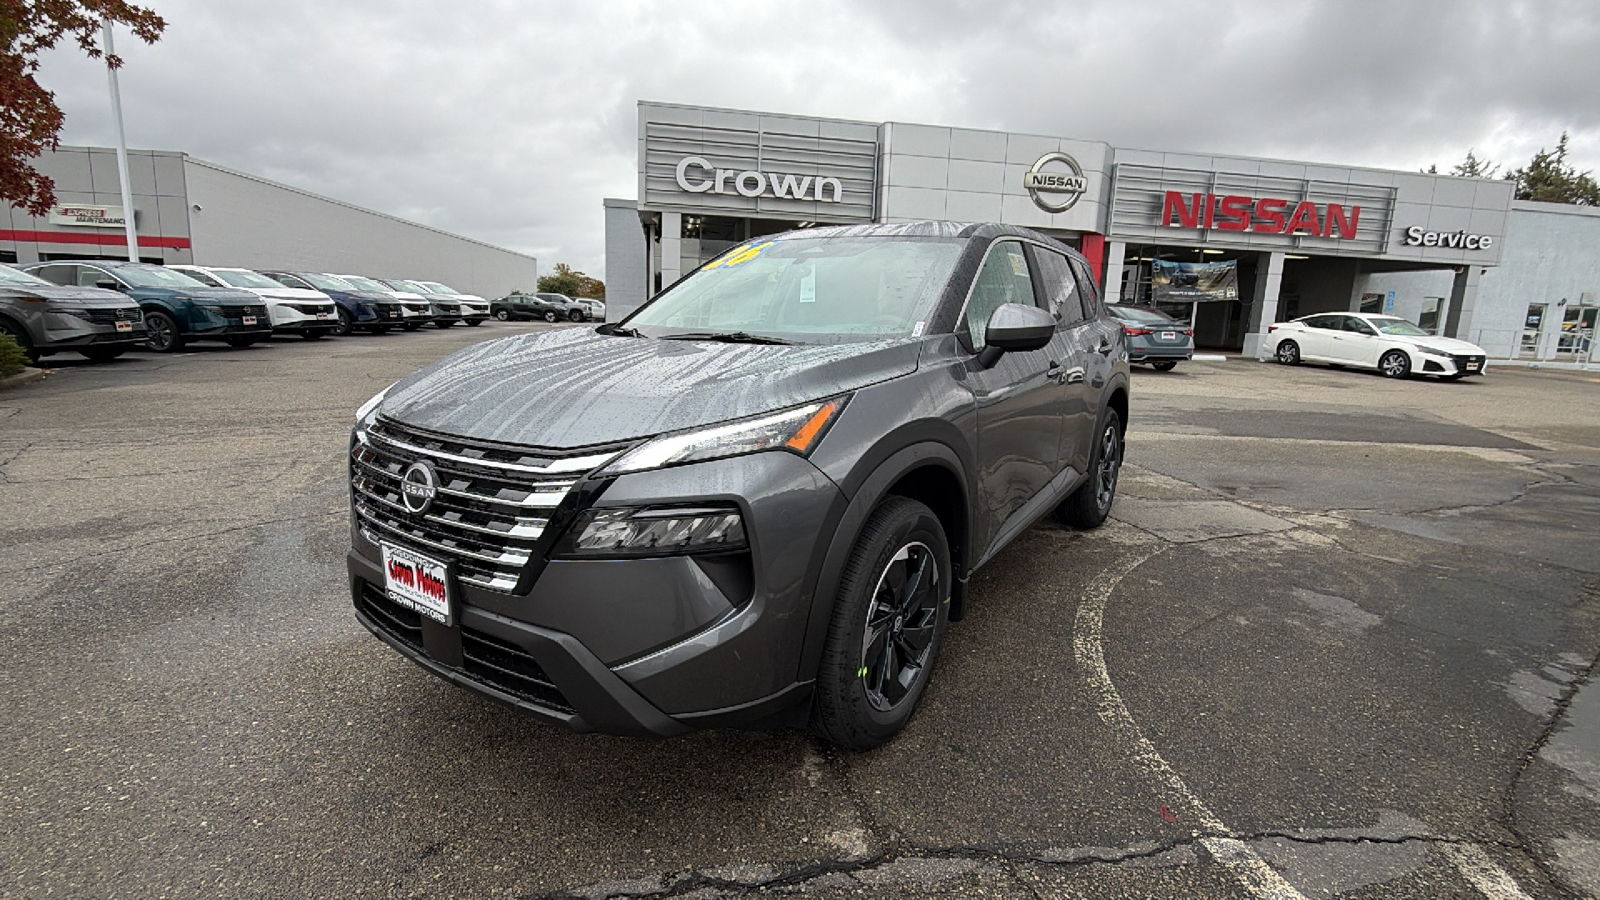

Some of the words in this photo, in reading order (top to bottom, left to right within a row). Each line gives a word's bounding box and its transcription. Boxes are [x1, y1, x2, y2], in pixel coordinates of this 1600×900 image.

[675, 156, 843, 203] Crown
[1032, 175, 1083, 189] NISSAN
[66, 208, 103, 218] EXPRESS
[76, 216, 126, 225] MAINTENANC
[1162, 190, 1361, 240] NISSAN
[1406, 225, 1493, 250] Service
[388, 591, 414, 609] CROWN
[414, 602, 446, 623] MOTORS
